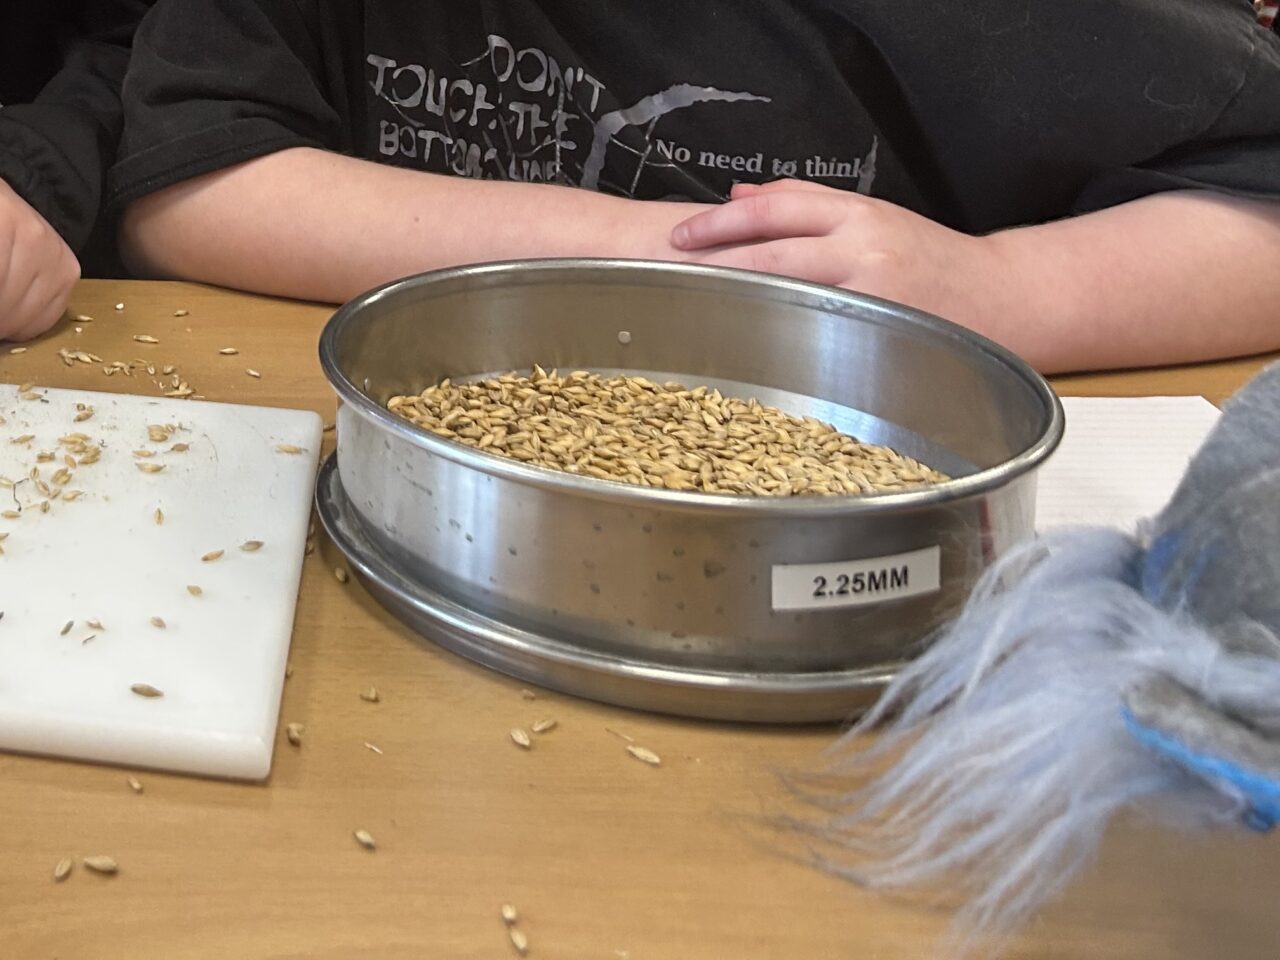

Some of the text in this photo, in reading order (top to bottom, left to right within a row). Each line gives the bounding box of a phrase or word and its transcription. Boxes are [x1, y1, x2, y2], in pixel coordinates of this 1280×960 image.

[487, 33, 607, 113] DON'T
[655, 139, 864, 178] No need to think
[812, 565, 909, 597] 2.25MM
